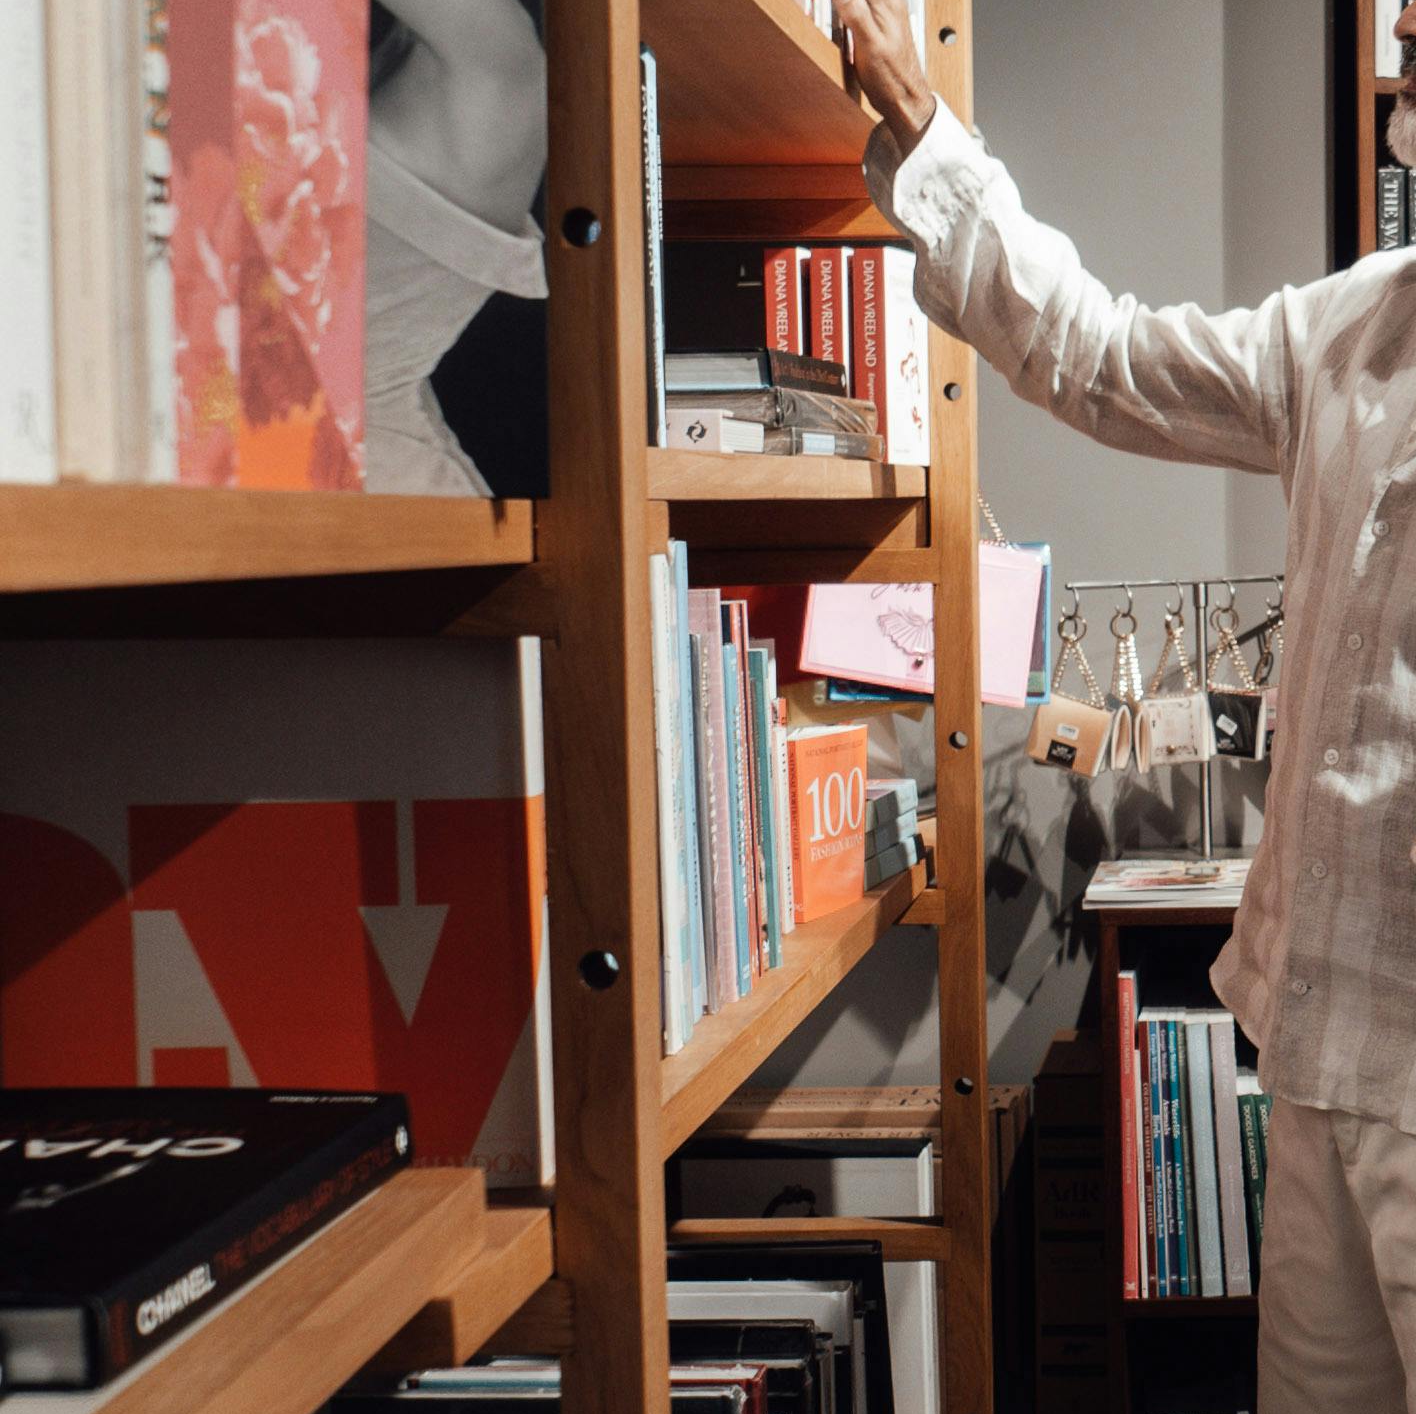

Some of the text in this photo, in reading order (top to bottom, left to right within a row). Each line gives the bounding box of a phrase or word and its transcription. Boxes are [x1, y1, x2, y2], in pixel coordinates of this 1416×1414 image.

[774, 260, 787, 304] DIANA
[820, 260, 833, 304] DIANA
[863, 260, 878, 367] DIANA VREELAND
[806, 766, 864, 843] 100
[809, 843, 844, 862] FASHION
[1152, 1114, 1161, 1139] Birds
[1162, 1098, 1171, 1135] Animals
[1171, 1098, 1181, 1139] Waterlife
[1243, 1104, 1259, 1180] DOODLE GARDENER
[135, 1261, 218, 1336] CHANEL
